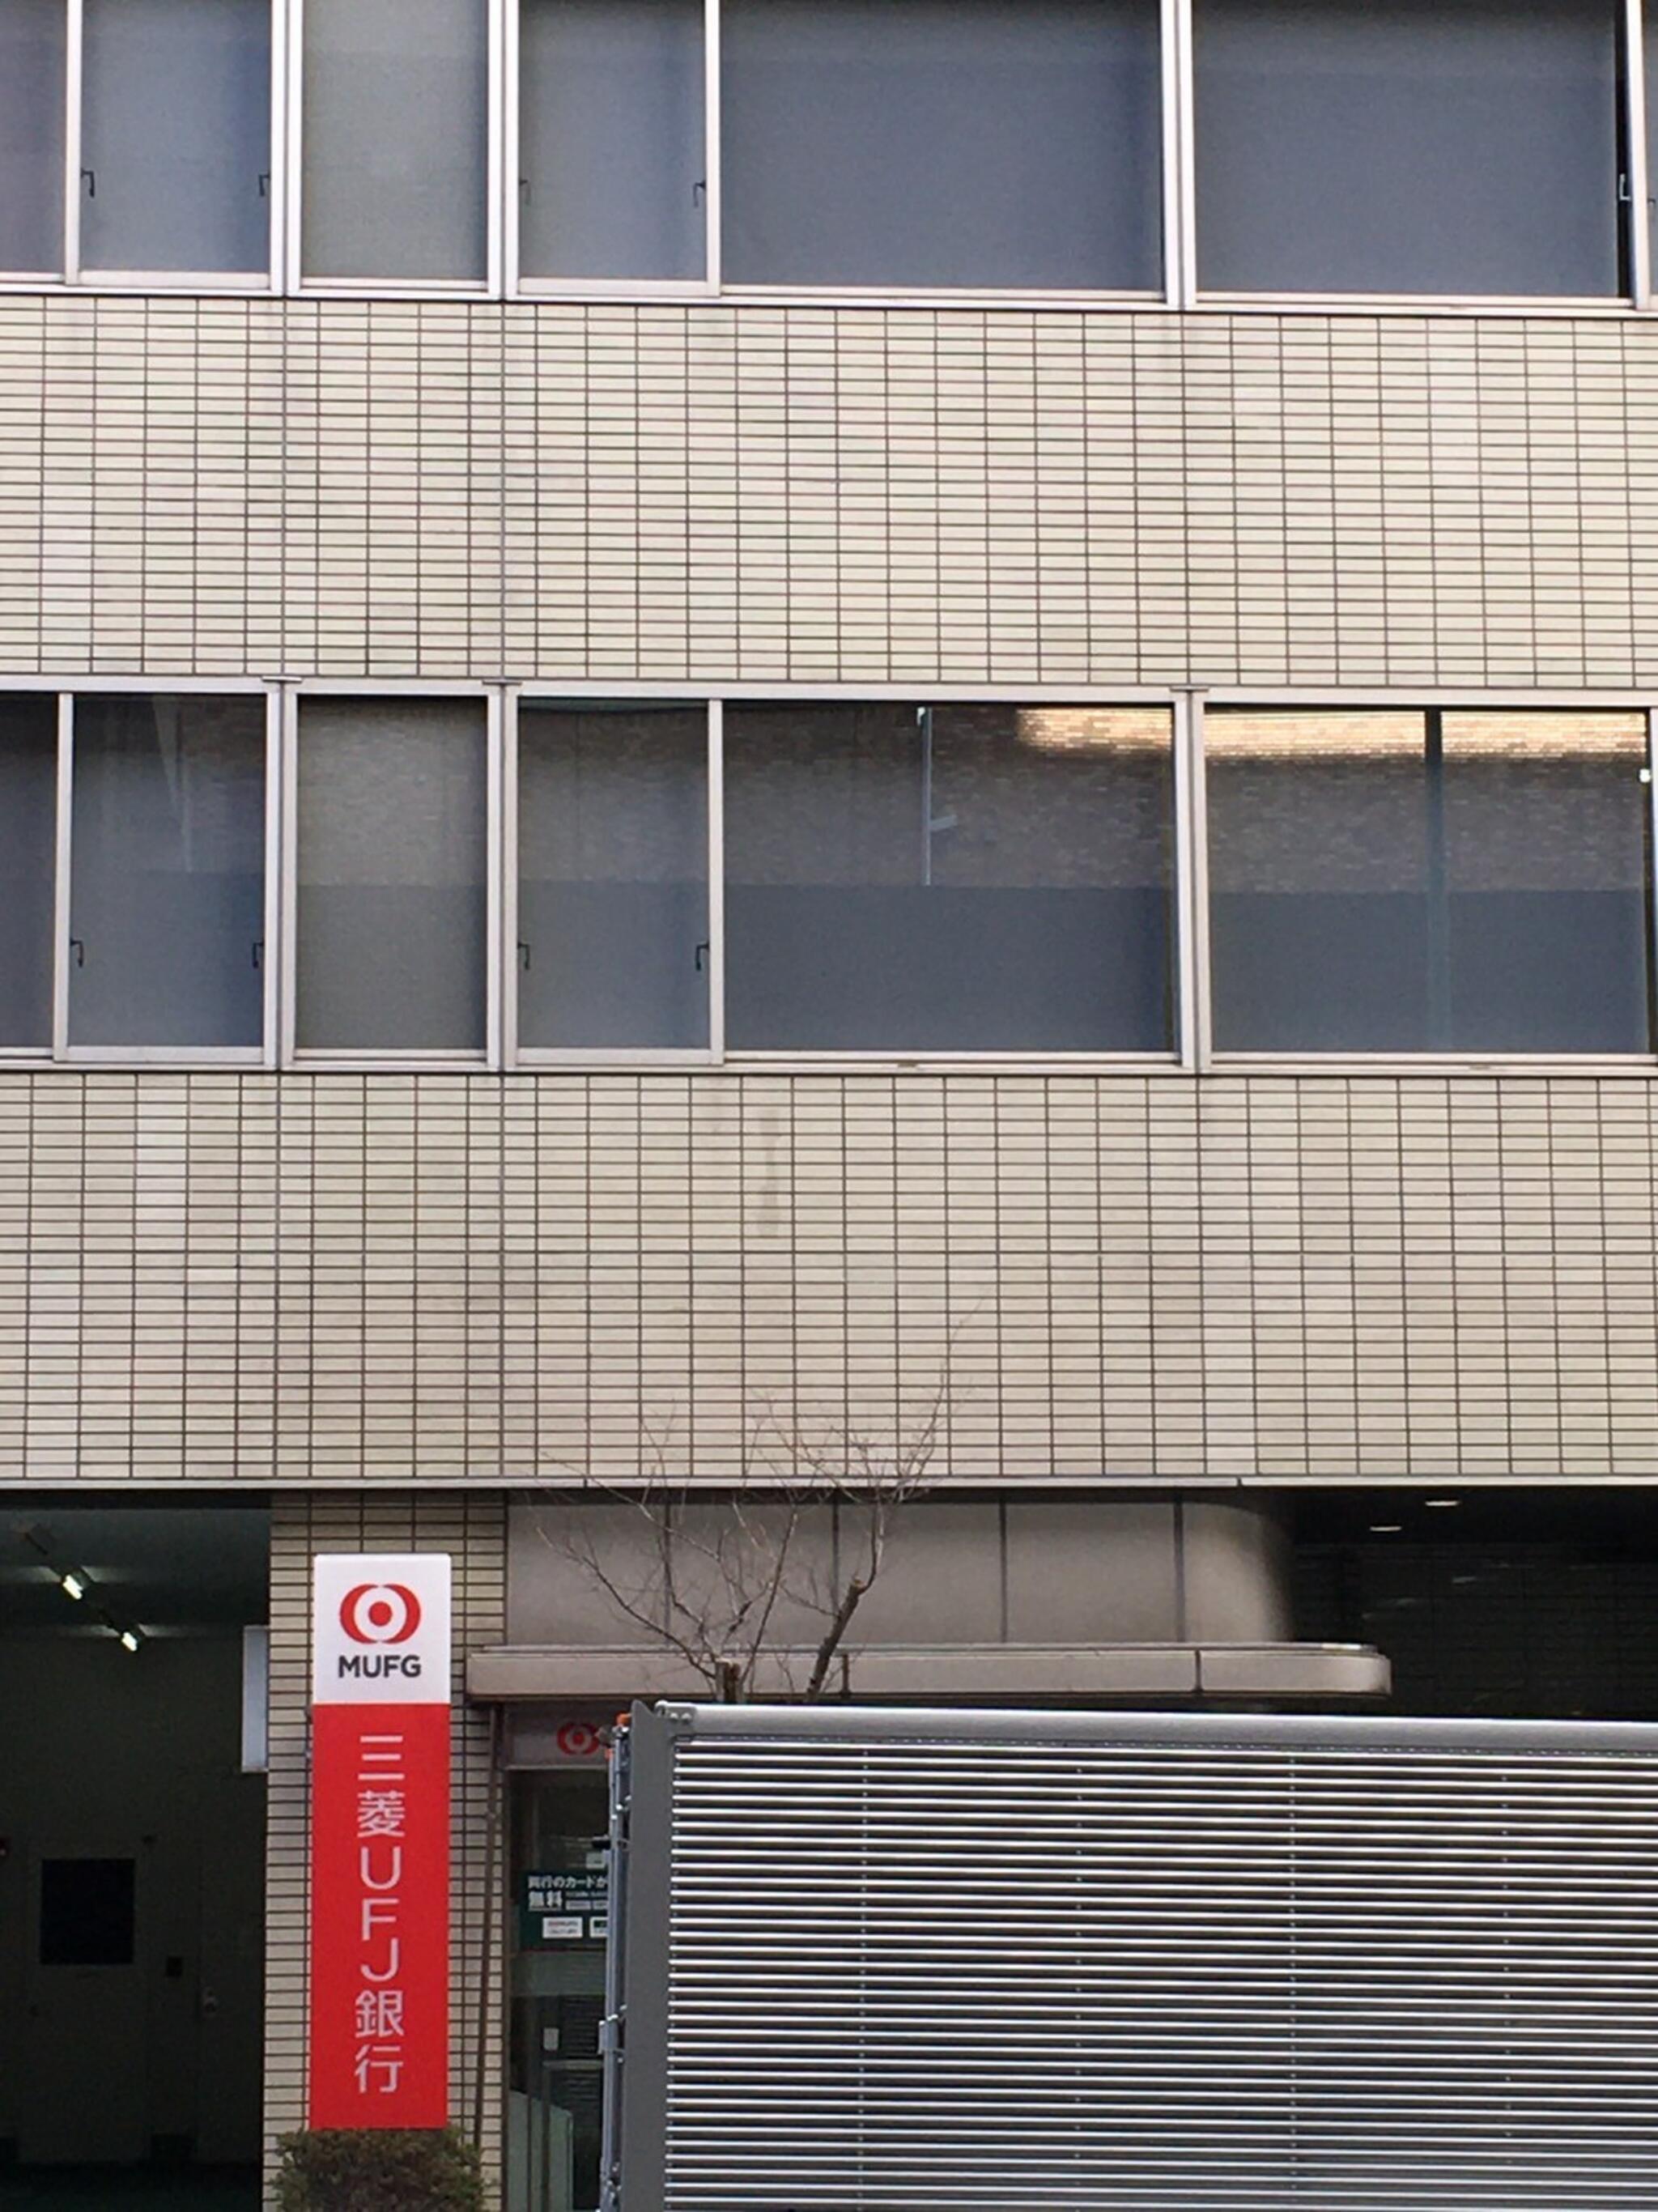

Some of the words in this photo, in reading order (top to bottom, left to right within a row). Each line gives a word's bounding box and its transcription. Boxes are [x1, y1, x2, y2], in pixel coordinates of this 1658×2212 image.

[338, 1655, 421, 1678] MUFG
[355, 1735, 406, 2093] 三菱UFJ銀行
